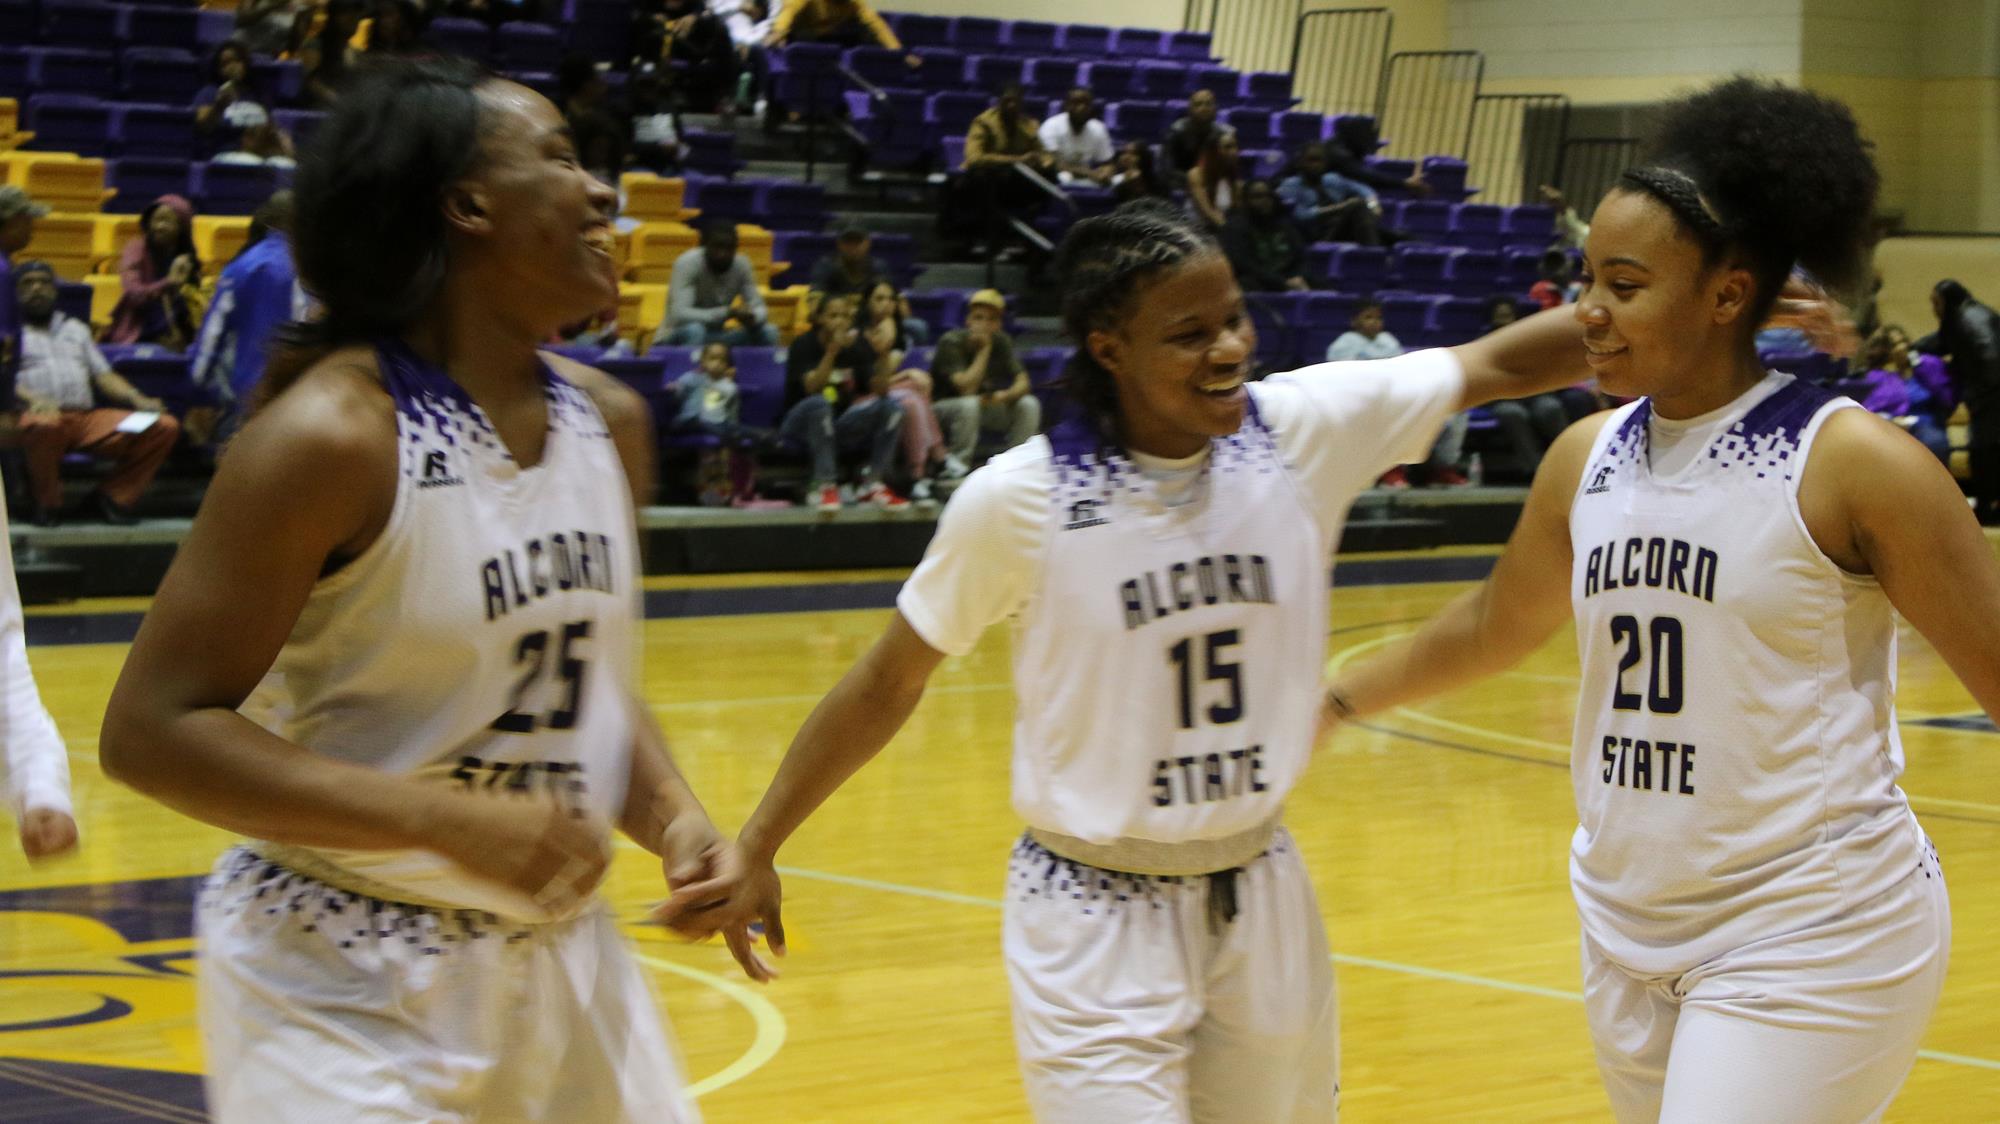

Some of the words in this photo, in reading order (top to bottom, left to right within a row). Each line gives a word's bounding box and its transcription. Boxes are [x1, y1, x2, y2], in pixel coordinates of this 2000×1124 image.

[480, 530, 615, 622] ALCORN
[1120, 554, 1277, 630] ALCORN
[1585, 537, 1718, 602] ALCORN
[492, 619, 594, 733] 25
[1168, 627, 1245, 729] 15
[1610, 615, 1683, 714] 20
[1152, 745, 1270, 807] STATE
[1602, 735, 1696, 795] STATE
